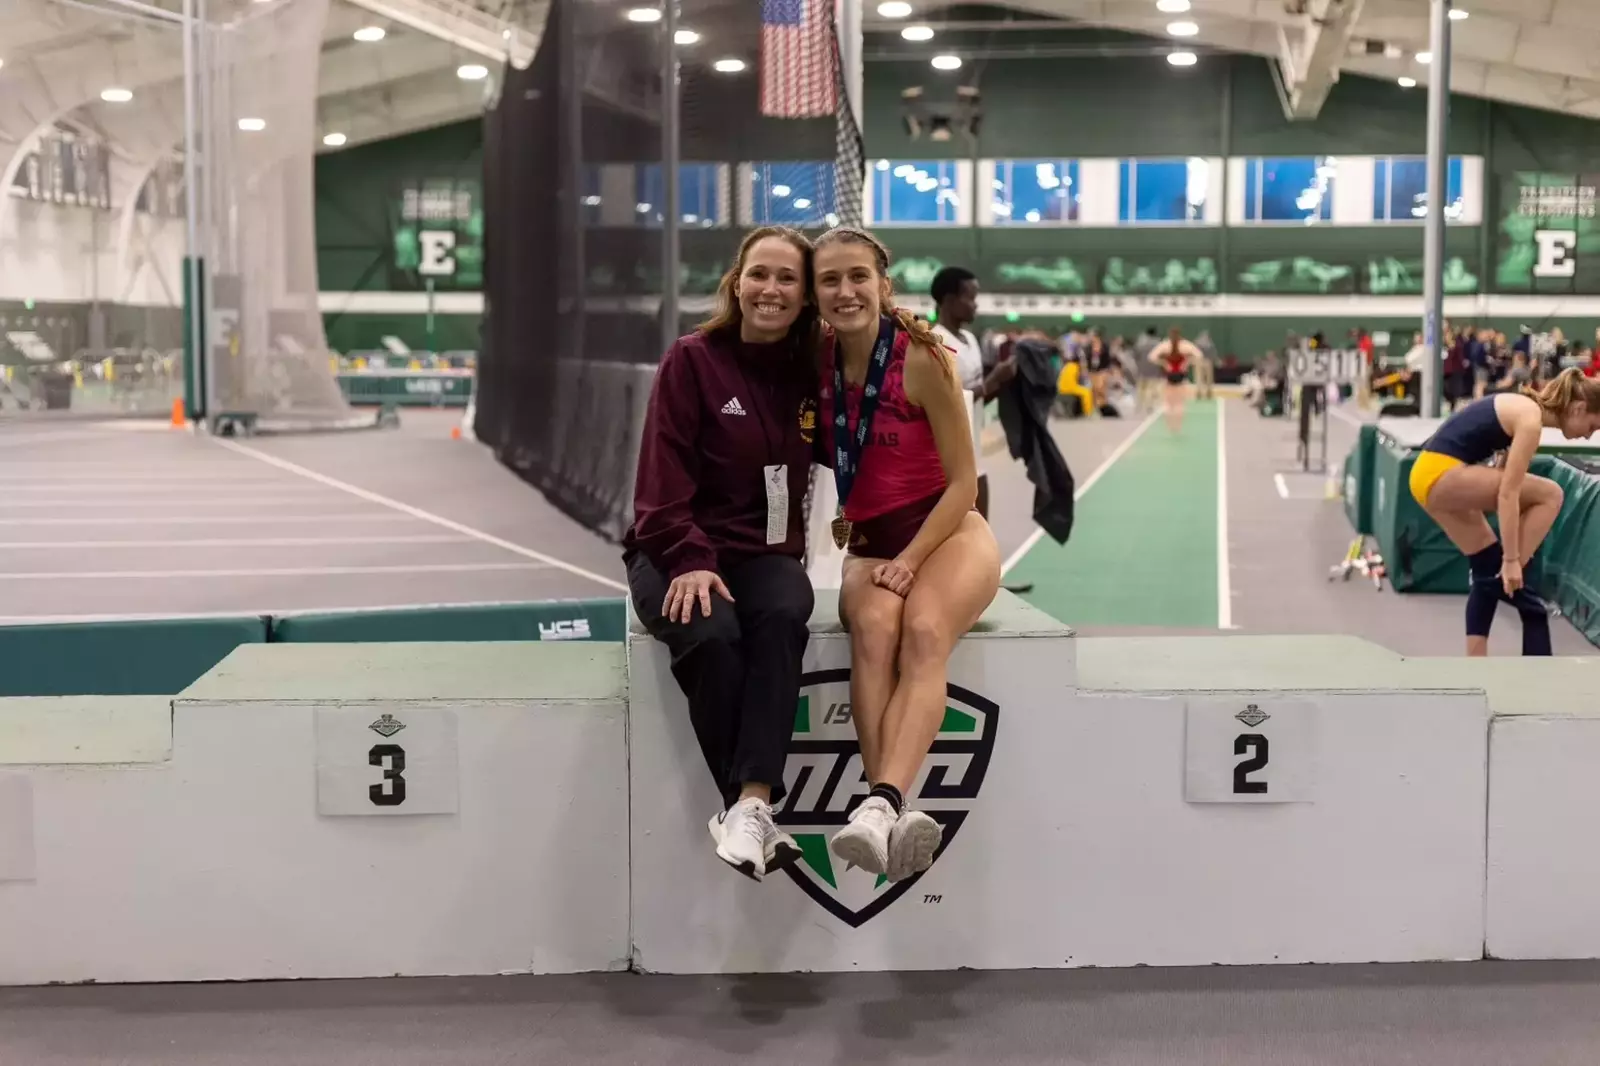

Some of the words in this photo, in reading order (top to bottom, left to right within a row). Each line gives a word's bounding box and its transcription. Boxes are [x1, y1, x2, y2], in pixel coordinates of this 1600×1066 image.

[418, 230, 456, 275] E
[1533, 230, 1576, 277] E
[721, 406, 747, 416] adidas
[823, 703, 852, 724] 19
[369, 744, 405, 806] 3
[1233, 734, 1268, 793] 2
[924, 895, 942, 904] TM
